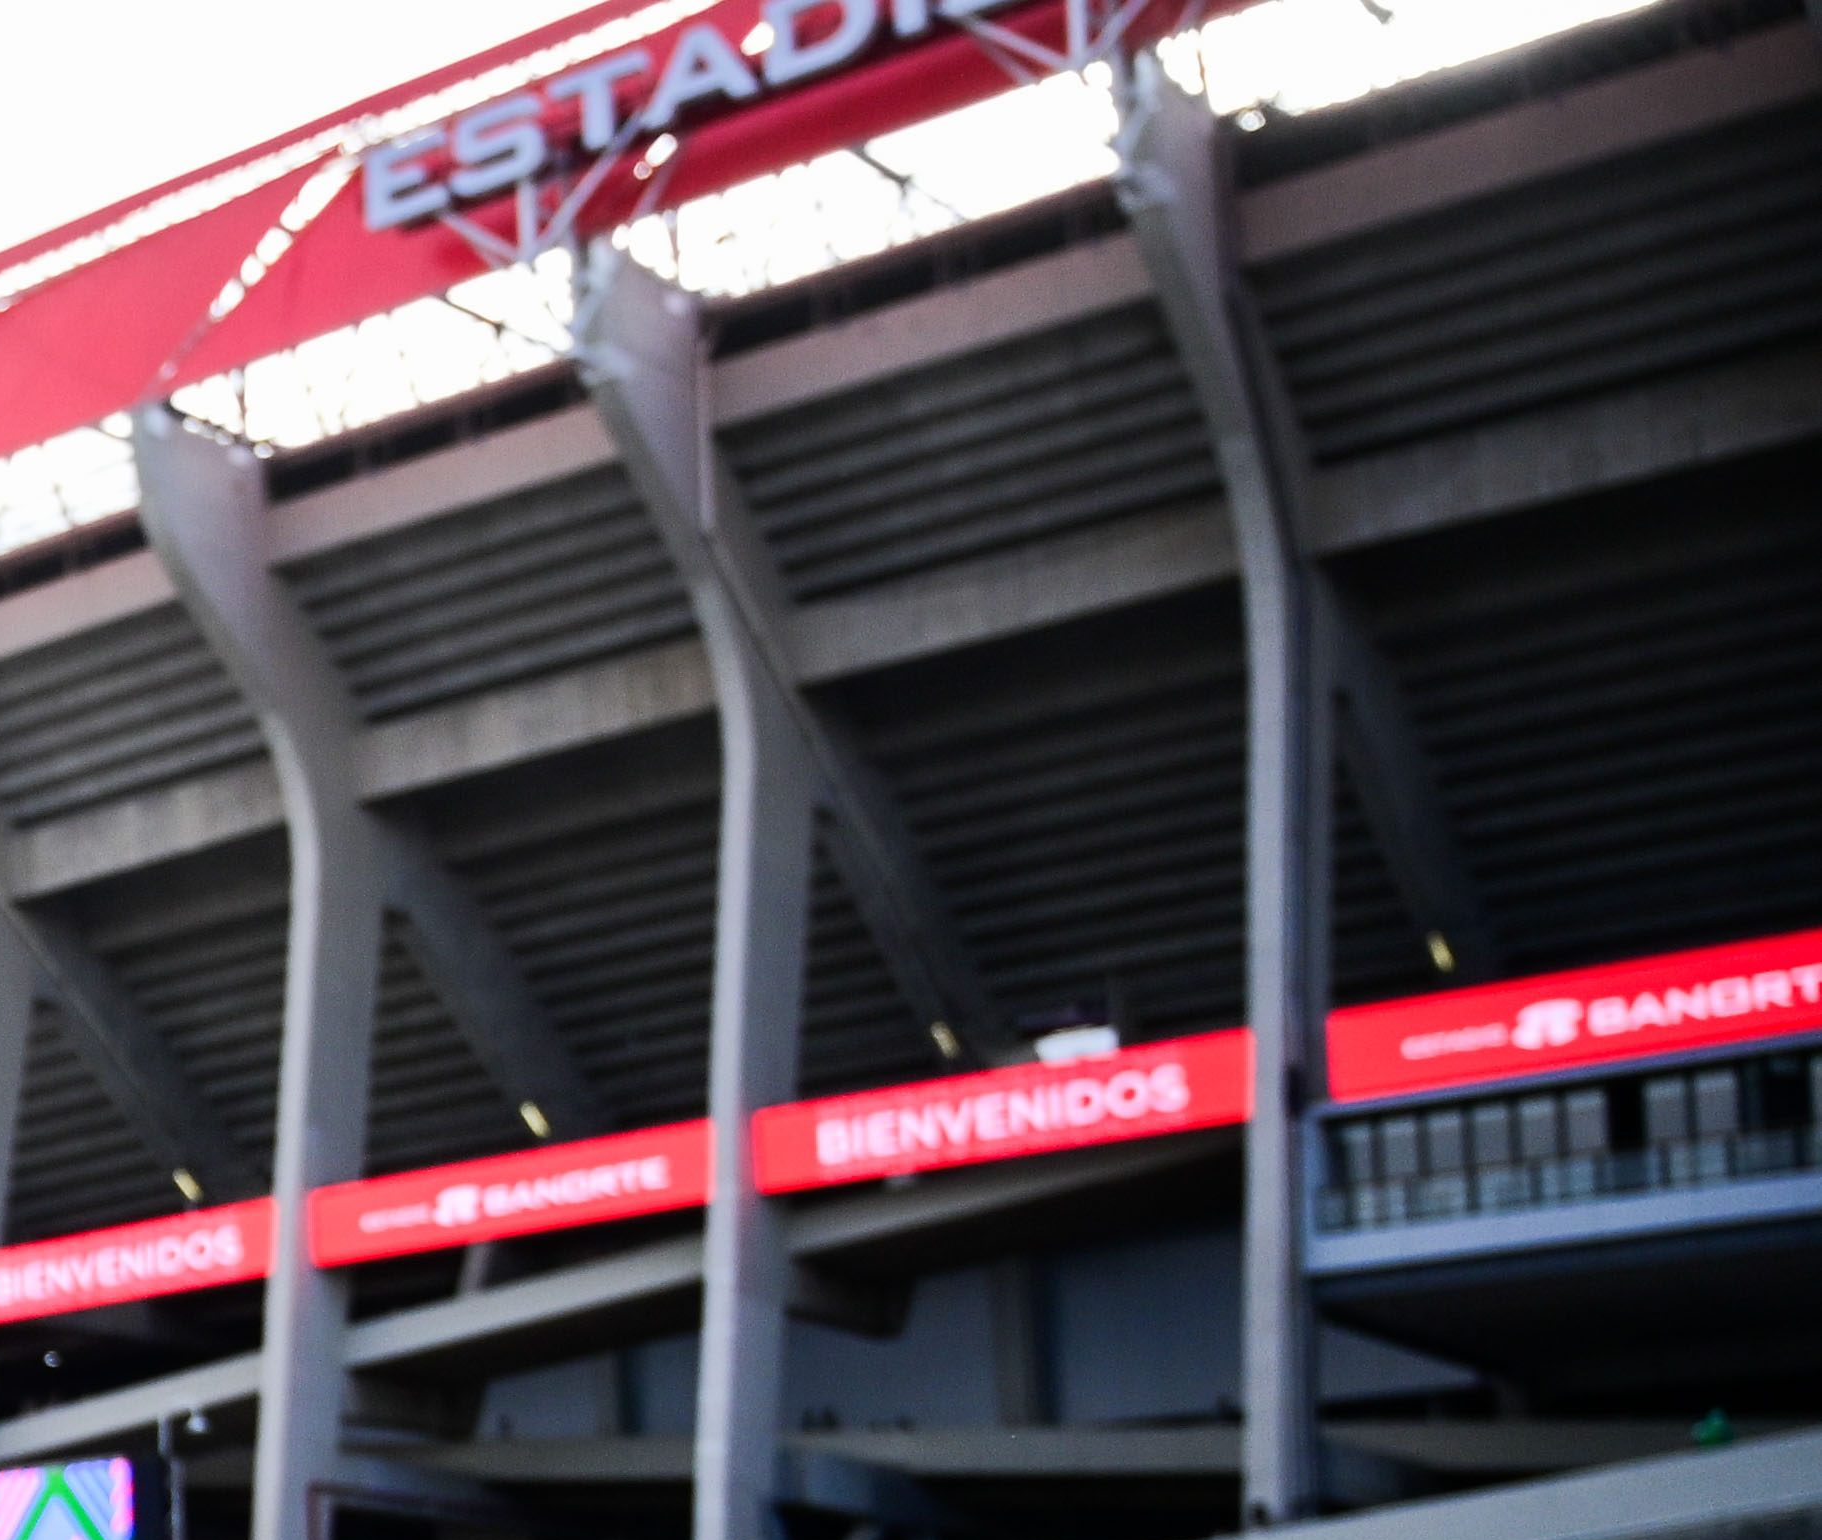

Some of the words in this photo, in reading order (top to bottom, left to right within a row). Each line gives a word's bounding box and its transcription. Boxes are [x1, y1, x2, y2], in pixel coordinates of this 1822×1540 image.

[361, 0, 1032, 232] ESTAD
[816, 1062, 1190, 1167] BIENVENIDOS
[482, 1155, 670, 1218] BANORTE
